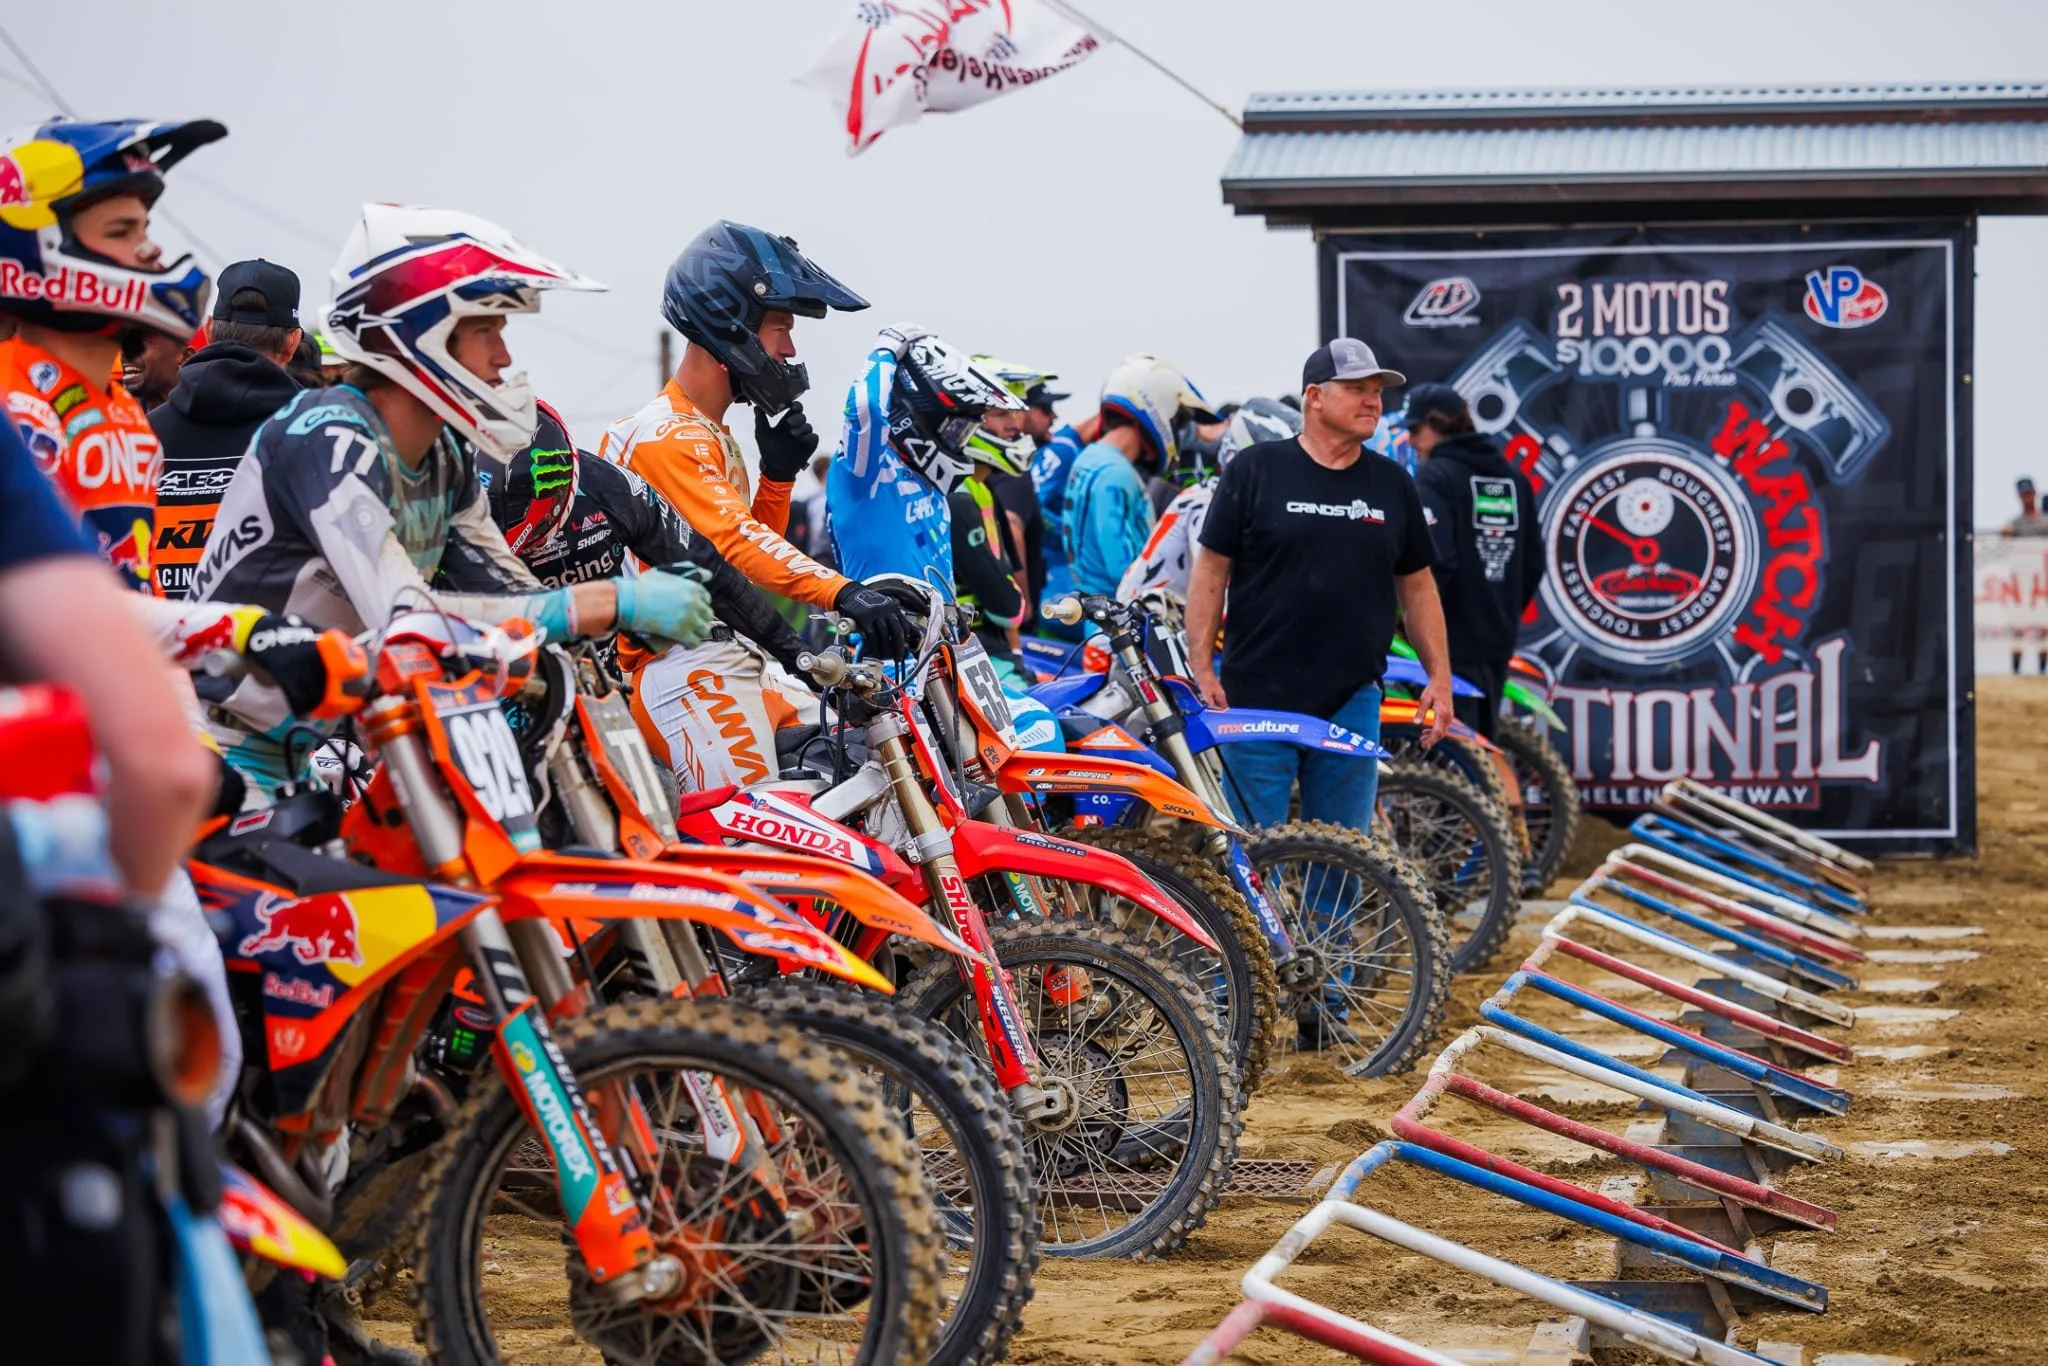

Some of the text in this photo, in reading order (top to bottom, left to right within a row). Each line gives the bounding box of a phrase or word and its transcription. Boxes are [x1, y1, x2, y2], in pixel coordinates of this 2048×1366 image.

[1, 259, 146, 313] Red Bull
[1556, 279, 1731, 338] 2 MOTOS
[1807, 267, 1862, 324] VP
[324, 425, 379, 476] 77
[1563, 468, 1628, 538] FASTEST
[1657, 466, 1732, 554] ROUGHEST
[1711, 401, 1823, 665] WATCH
[542, 550, 615, 588] acing
[577, 529, 613, 550] SHOWA
[1561, 561, 1641, 637] TOUGHEST
[1658, 564, 1730, 636] BADDEST
[686, 668, 770, 787] CANVA
[963, 659, 1013, 732] 53
[1217, 720, 1300, 735] mxculture
[1515, 637, 1881, 782] TIONAL
[726, 810, 856, 862] HONDA
[1016, 835, 1087, 857] PROPANE
[264, 974, 335, 1008] Red Bull
[990, 984, 1028, 1065] SKECHERS
[524, 1069, 596, 1184] MOTOREX
